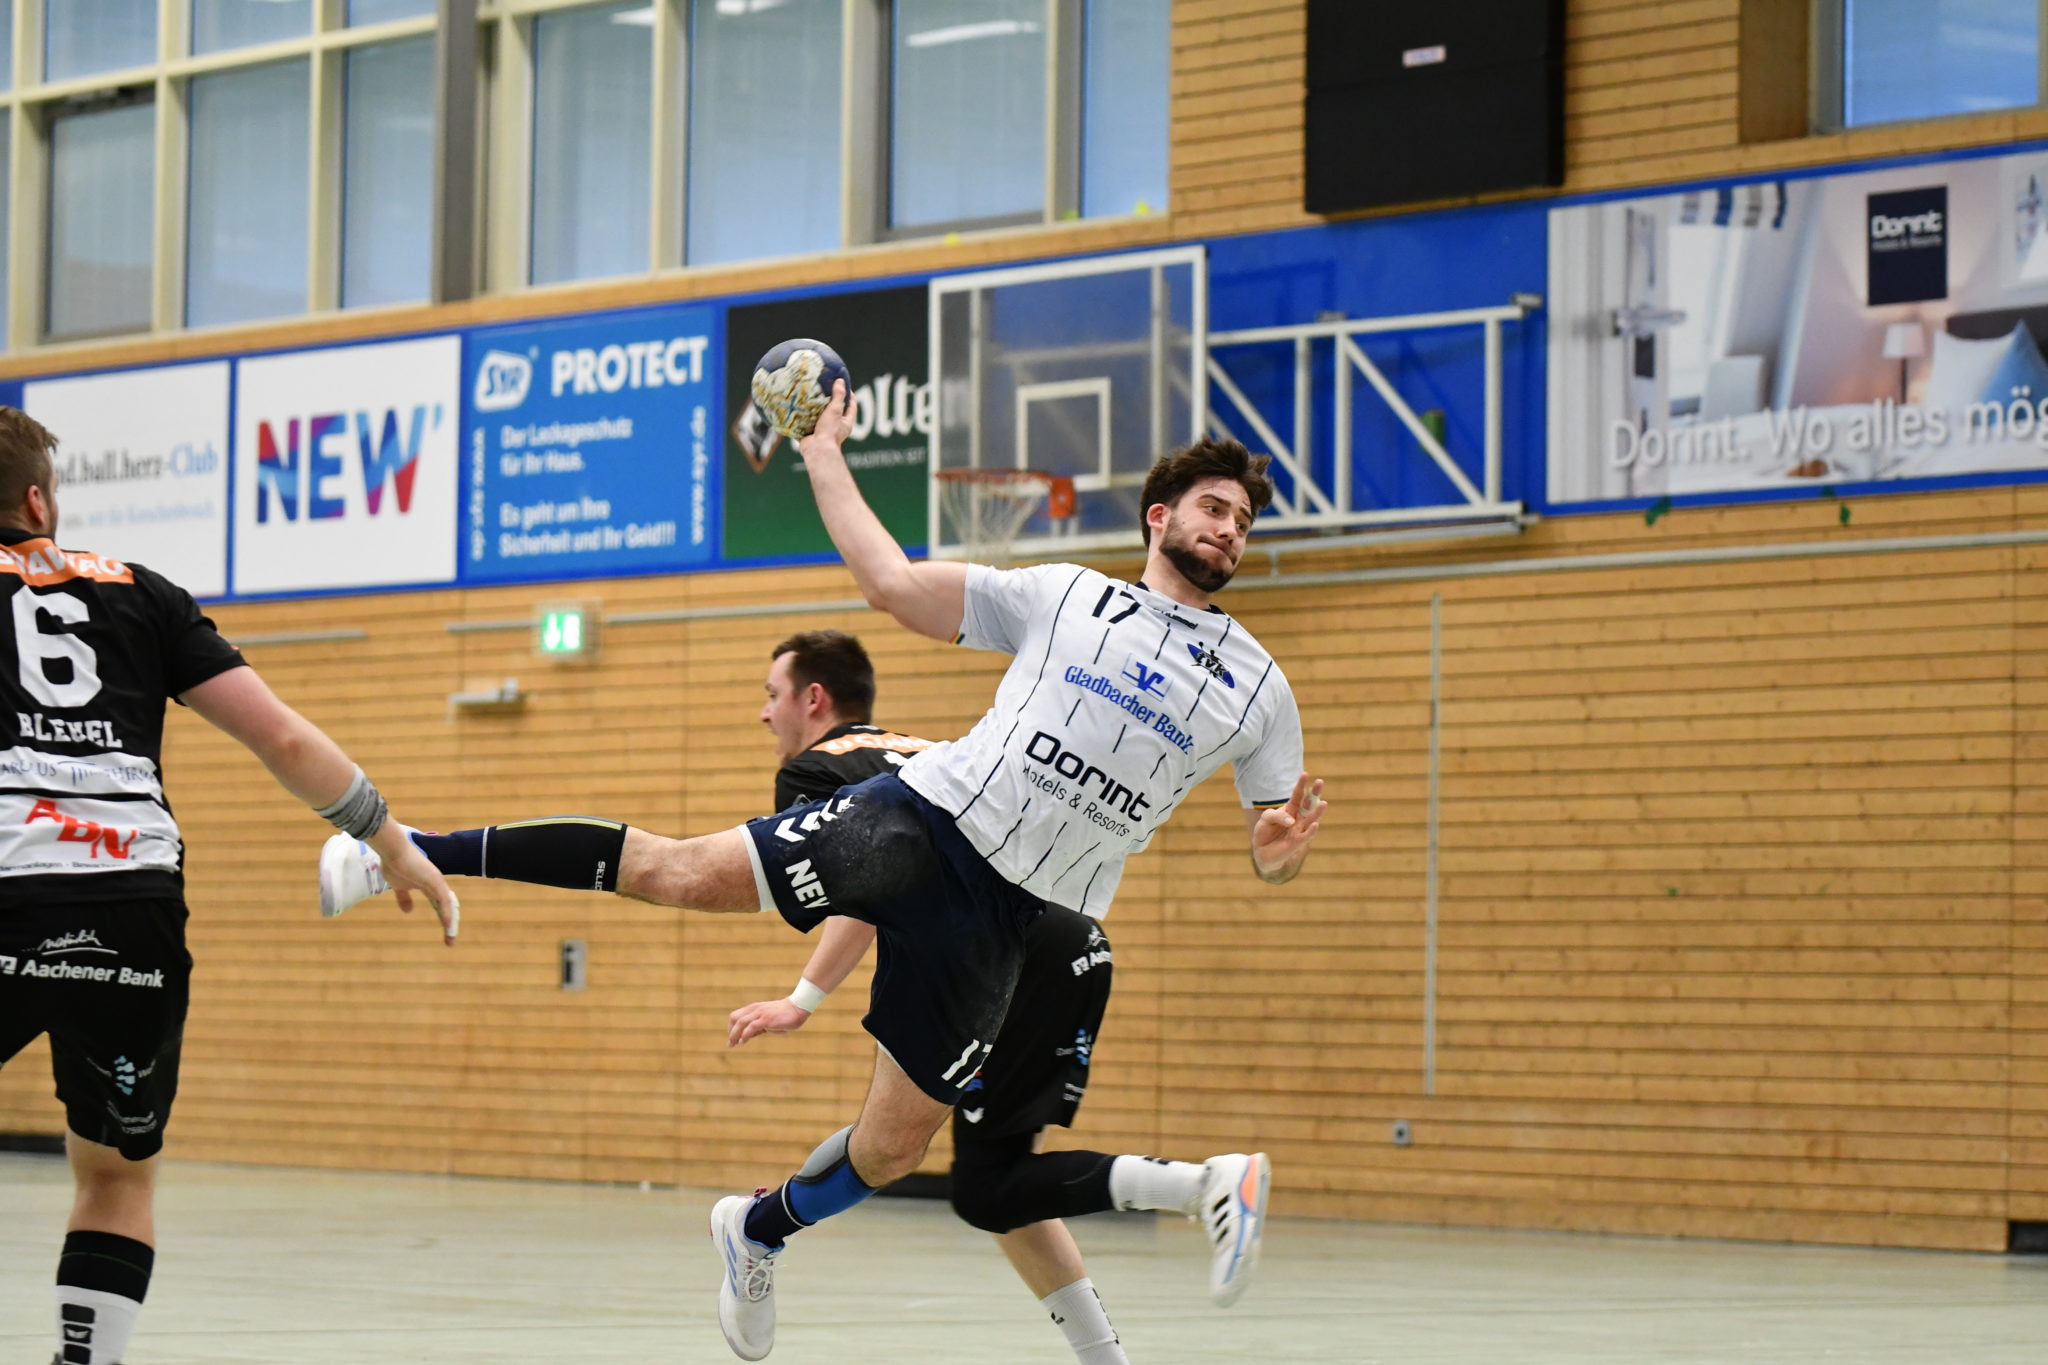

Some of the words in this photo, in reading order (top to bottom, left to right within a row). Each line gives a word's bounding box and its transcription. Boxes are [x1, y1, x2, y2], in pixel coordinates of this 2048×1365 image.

[551, 335, 709, 397] PROTECT
[502, 425, 527, 450] Der
[1608, 411, 1752, 468] Dorint.
[1763, 403, 1833, 459] Wo
[1848, 397, 1949, 451] alles
[501, 452, 521, 477] für
[523, 451, 544, 475] Ihr
[501, 503, 520, 528] Es
[522, 500, 554, 531] geht
[556, 502, 581, 523] um
[582, 496, 611, 520] Ihre
[574, 527, 600, 552] und
[602, 525, 624, 550] Ihr
[1092, 585, 1142, 624] 17
[12, 585, 102, 708] 6
[1064, 665, 1156, 724] Gladbacher
[1152, 713, 1193, 755] Bank
[1025, 731, 1150, 822] Dorint
[1068, 793, 1081, 810] &
[1083, 802, 1130, 837] Resorts
[20, 959, 116, 983] Aachener
[117, 967, 165, 988] Bank
